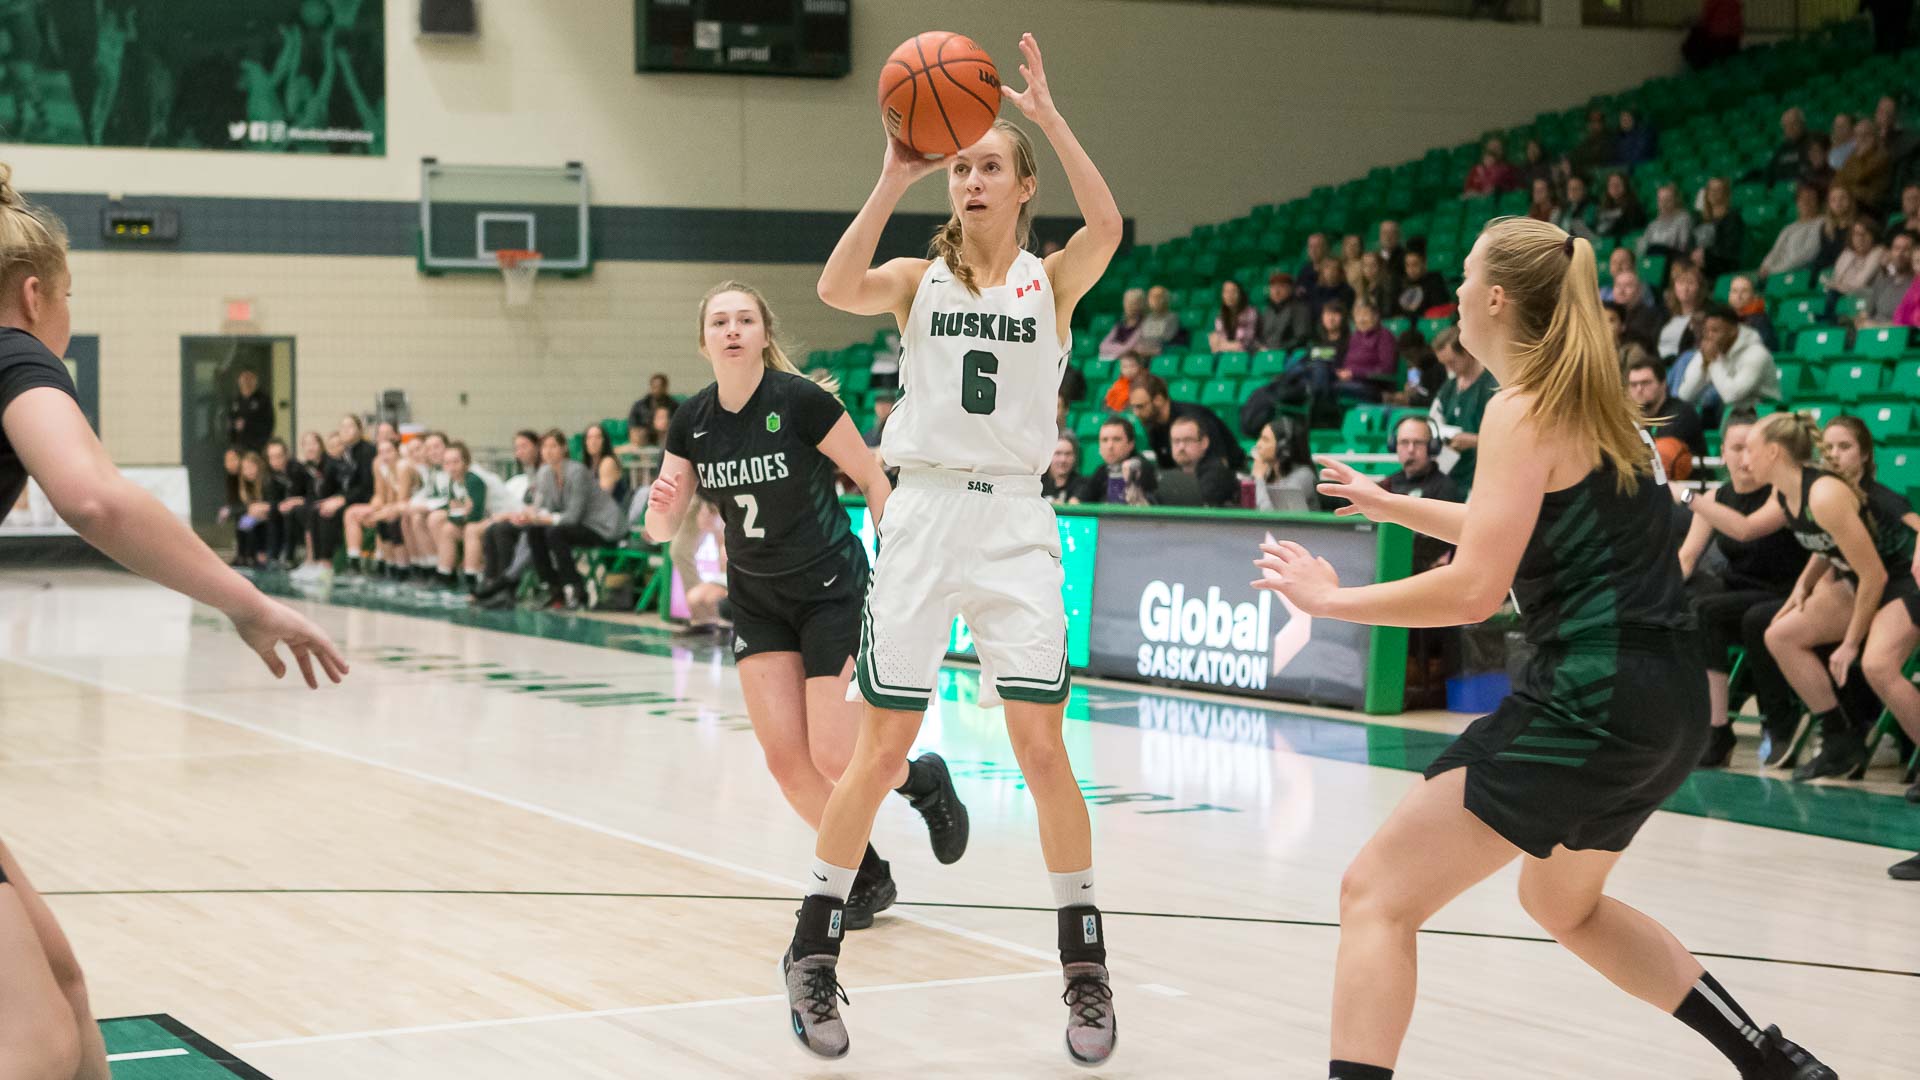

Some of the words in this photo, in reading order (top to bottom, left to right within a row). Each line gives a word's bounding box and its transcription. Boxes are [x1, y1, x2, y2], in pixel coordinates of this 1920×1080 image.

[931, 312, 1036, 343] HUSKIES
[962, 349, 998, 415] 6
[697, 452, 789, 488] CASCADES
[968, 481, 994, 494] SASK
[734, 494, 765, 538] 2
[1139, 580, 1271, 652] Global
[1137, 643, 1267, 690] SASKATOON
